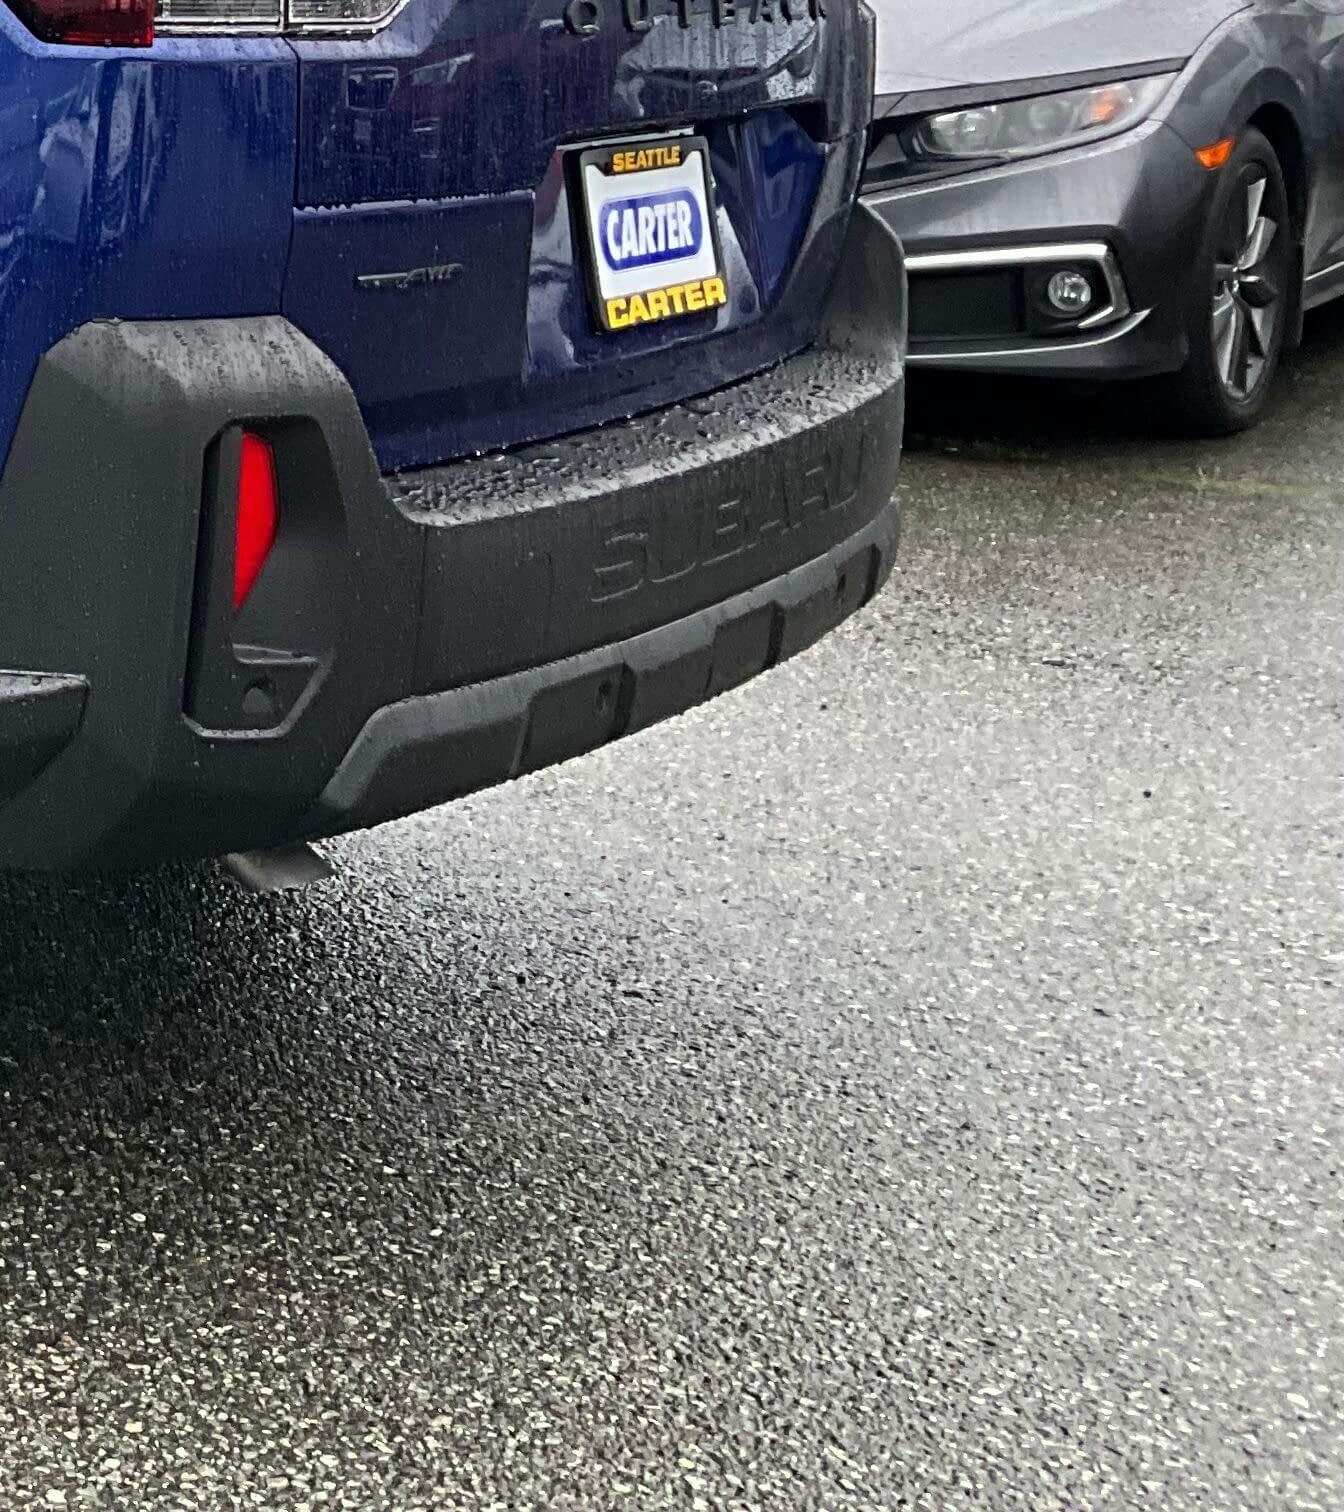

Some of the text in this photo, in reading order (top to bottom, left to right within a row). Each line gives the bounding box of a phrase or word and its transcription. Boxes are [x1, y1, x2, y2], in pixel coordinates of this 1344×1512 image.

[613, 145, 681, 173] SEATTLE
[607, 200, 694, 261] CARTER
[606, 277, 727, 329] CARTER
[590, 451, 860, 602] SUBARU
